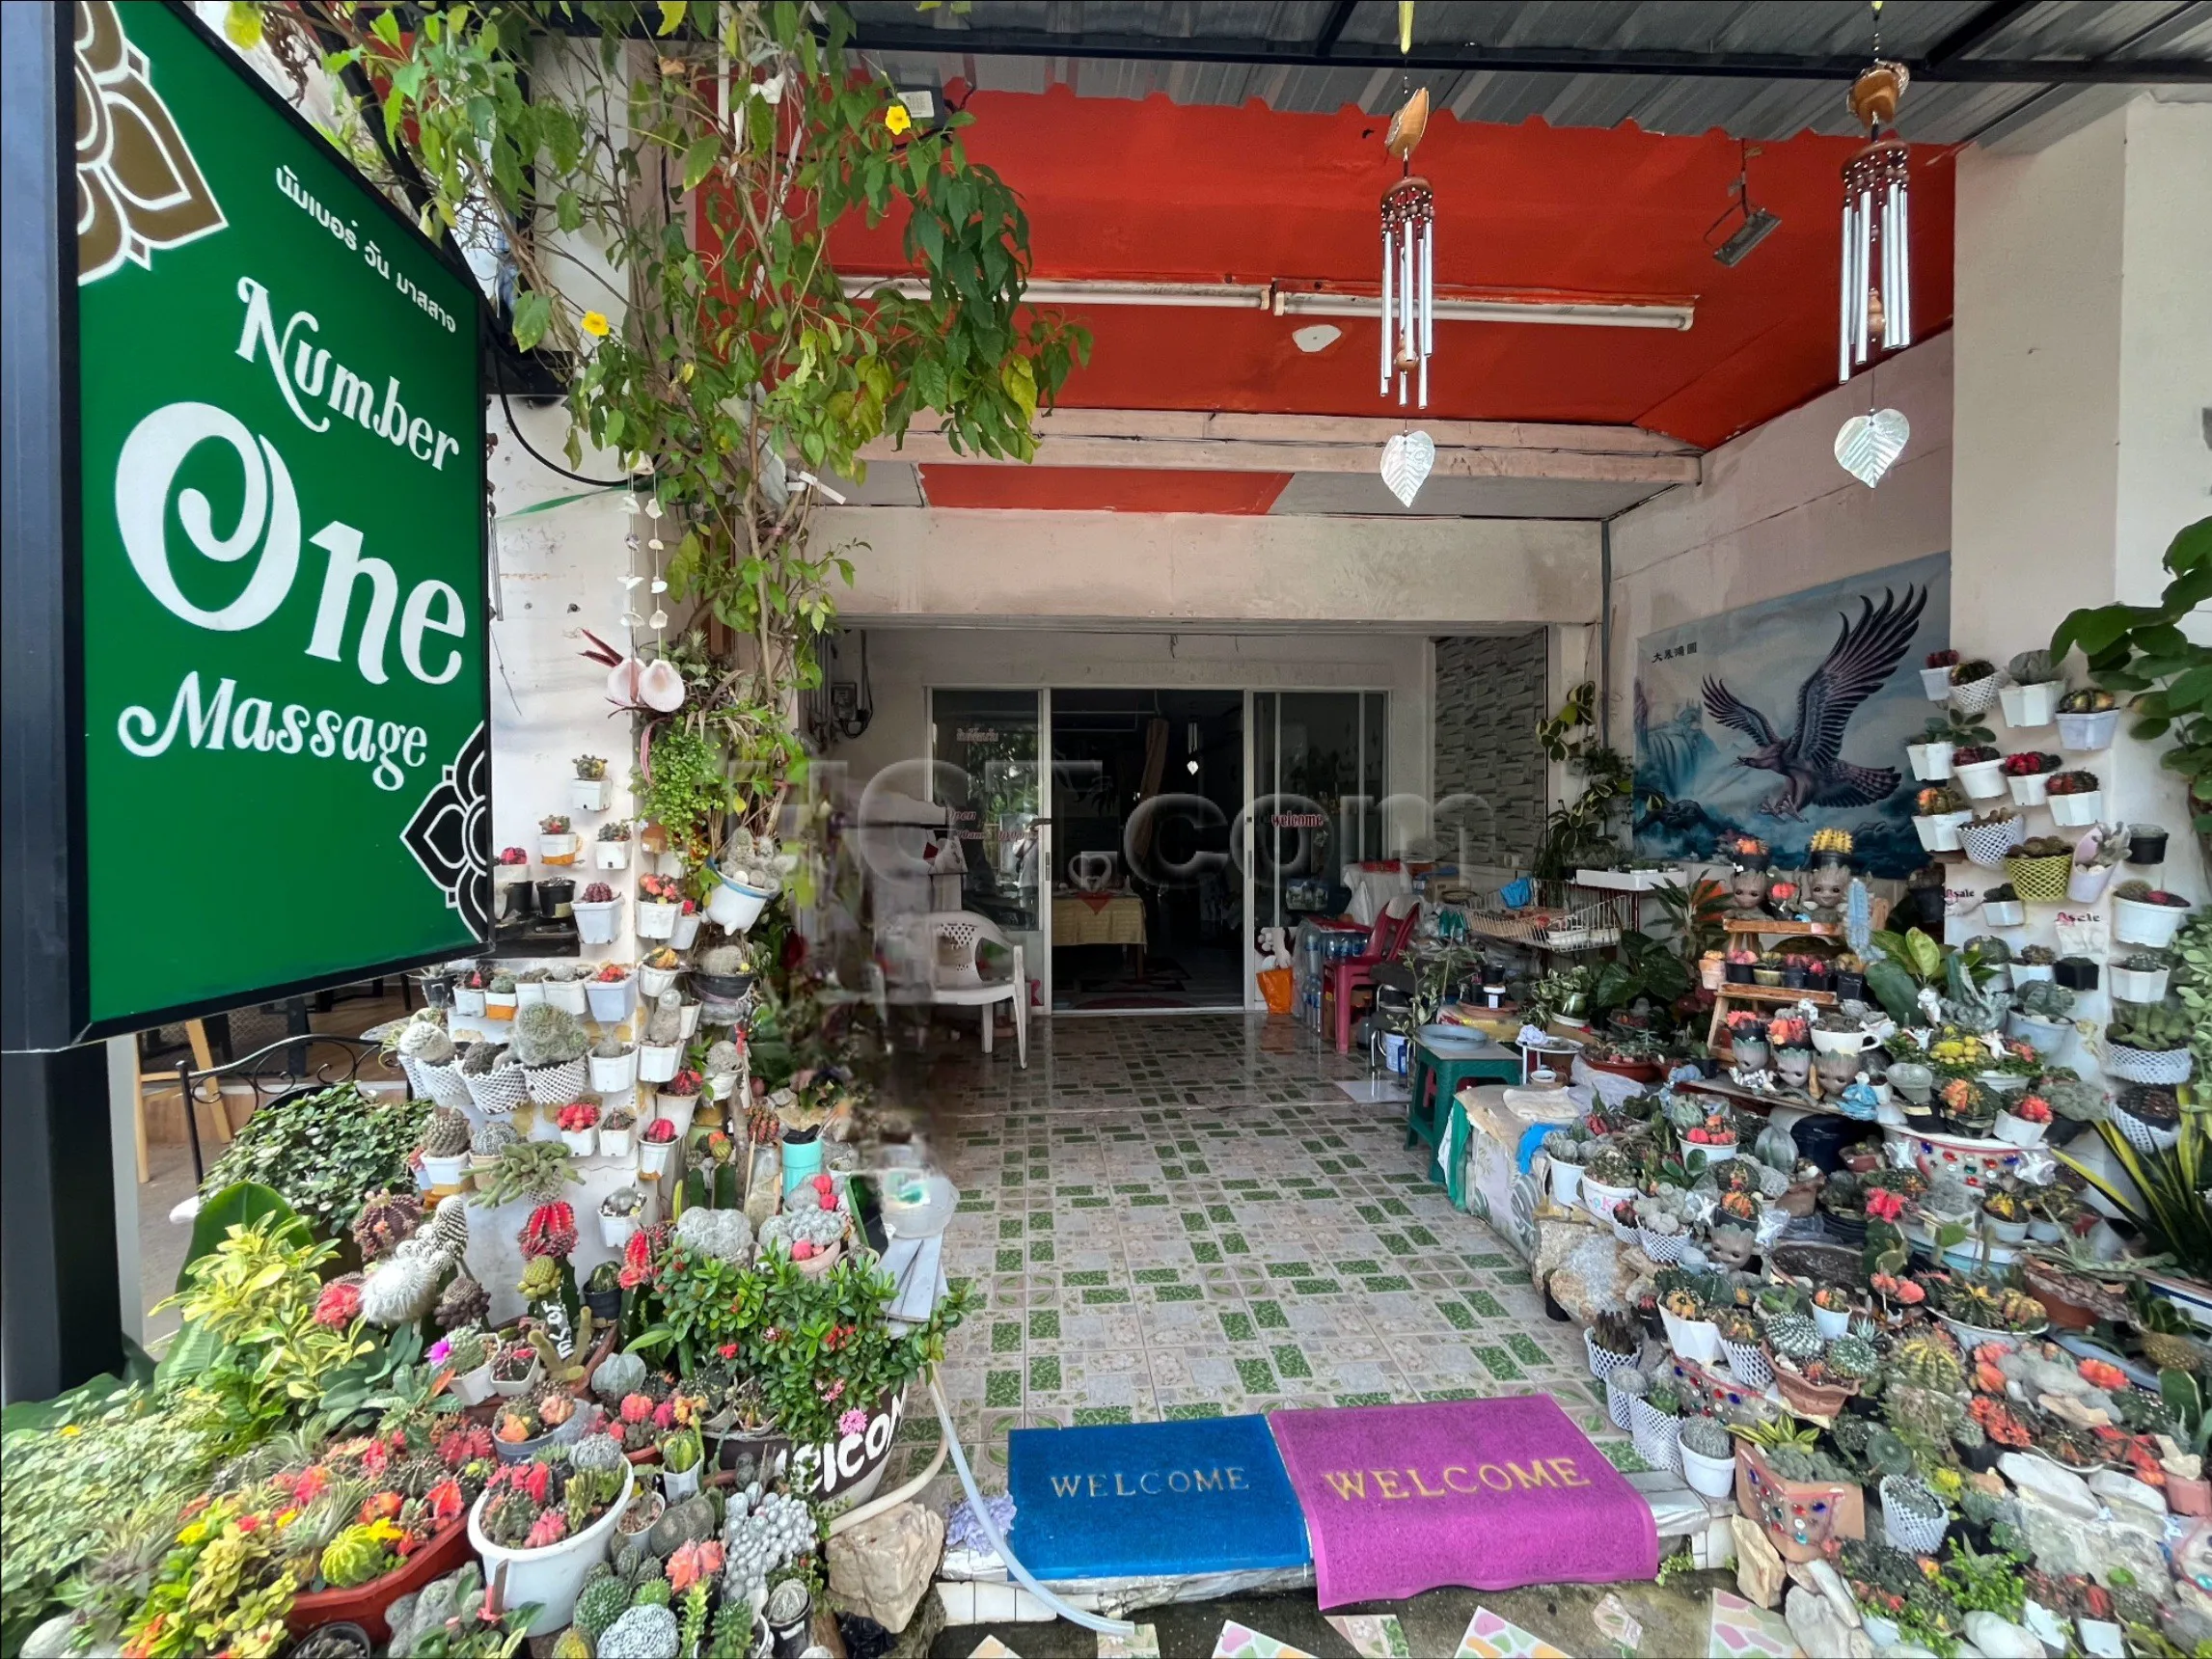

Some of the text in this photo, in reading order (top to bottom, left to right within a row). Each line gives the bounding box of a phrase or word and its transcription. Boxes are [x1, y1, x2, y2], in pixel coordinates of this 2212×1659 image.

[365, 240, 390, 280] วัน
[235, 276, 460, 472] Number
[115, 401, 467, 685] One
[117, 670, 428, 791] Massage
[1051, 1466, 1251, 1499] WELCOME
[1324, 1457, 1593, 1501] WELCOME
